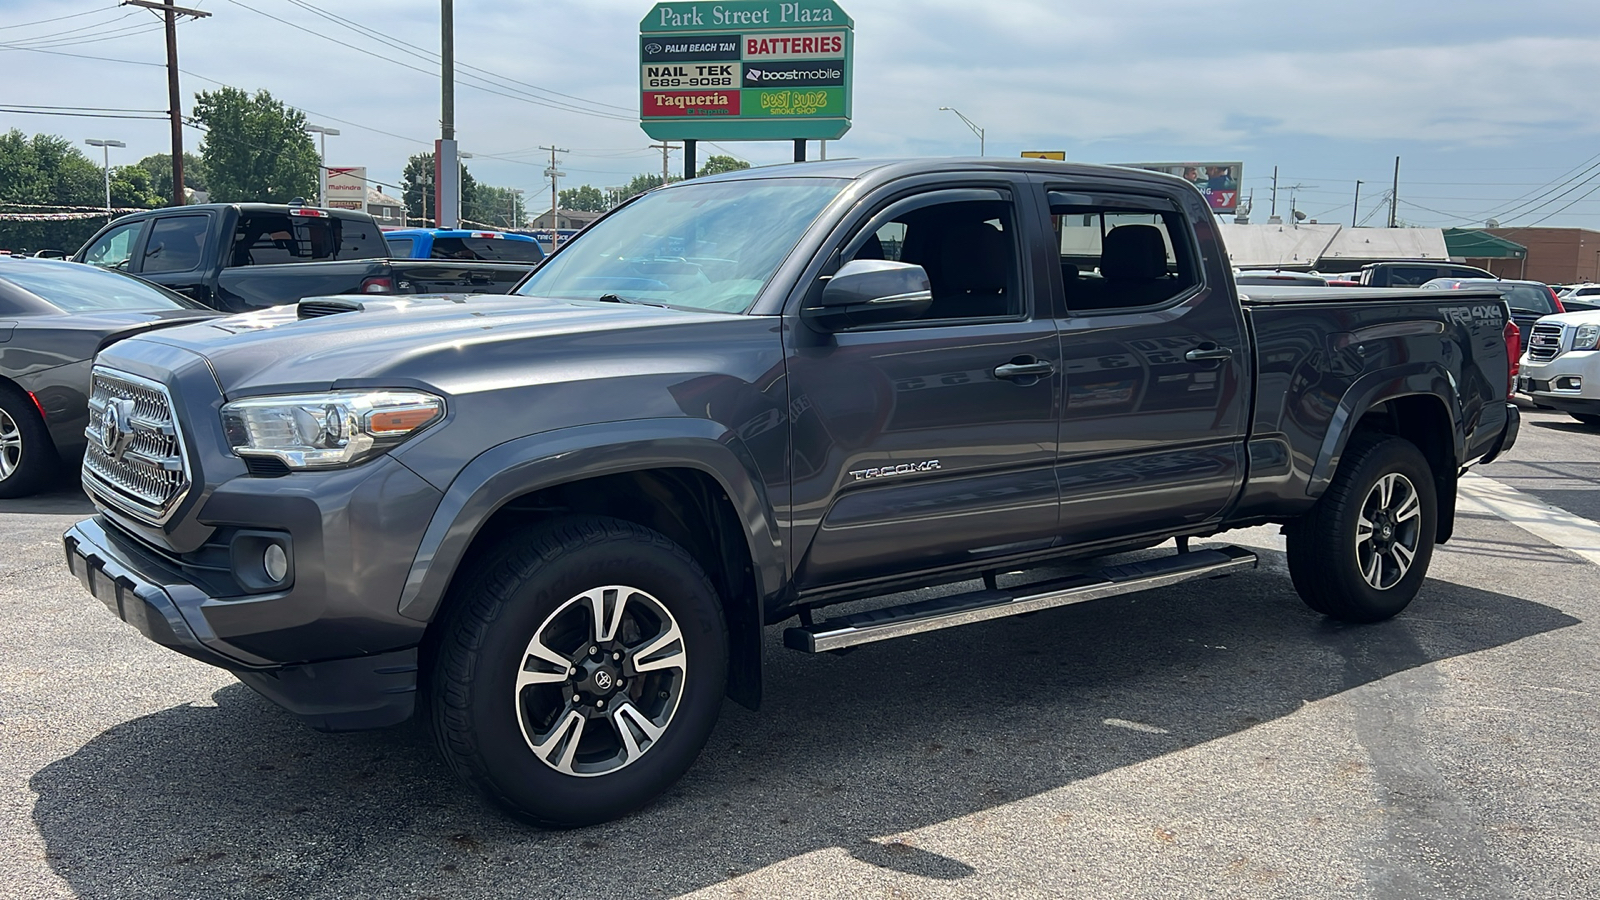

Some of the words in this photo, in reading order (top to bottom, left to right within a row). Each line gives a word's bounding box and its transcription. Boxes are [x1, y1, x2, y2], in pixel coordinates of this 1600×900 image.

[659, 6, 704, 26] Park
[712, 5, 770, 25] Street
[779, 2, 833, 23] Plaza
[664, 44, 688, 53] PALM
[689, 43, 717, 52] BEACH
[719, 43, 736, 52] TAN
[747, 36, 842, 55] BATTERIES
[648, 67, 688, 77] NAIL
[695, 65, 733, 76] TEK
[649, 77, 732, 87] 689-9088
[770, 107, 795, 115] SMOKE
[796, 107, 817, 115] SHOP
[1438, 306, 1473, 327] TRD
[849, 459, 942, 480] TACOMA
